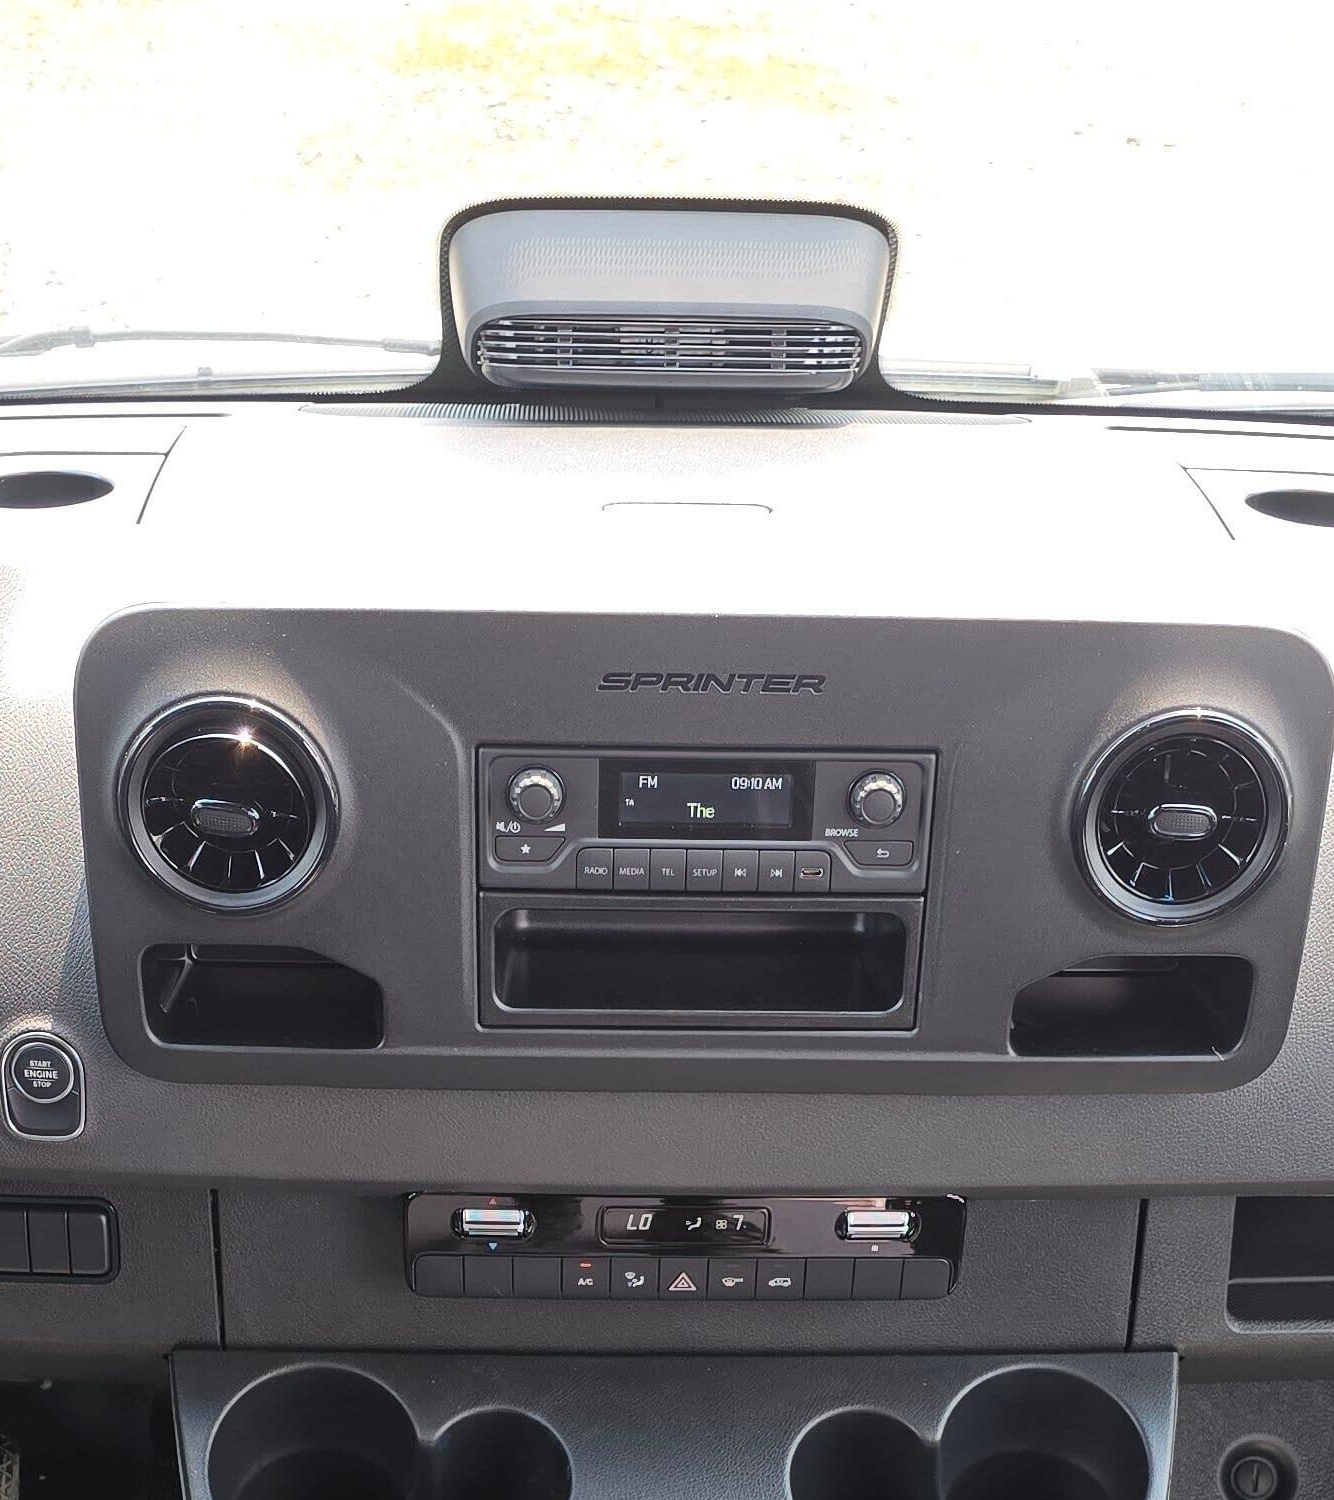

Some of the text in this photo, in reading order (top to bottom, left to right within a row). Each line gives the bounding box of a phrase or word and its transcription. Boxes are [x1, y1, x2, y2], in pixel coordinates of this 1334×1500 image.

[596, 672, 828, 695] SPRINTER
[639, 775, 783, 790] FM 09:10 AM
[686, 802, 715, 819] The
[825, 828, 859, 837] BROWSE
[584, 866, 608, 875] RADIO
[619, 867, 645, 876] MEDIA
[661, 868, 675, 877] TEL
[692, 868, 718, 877] SETUP
[24, 1069, 59, 1079] ENGINE
[626, 1213, 653, 1231] LO
